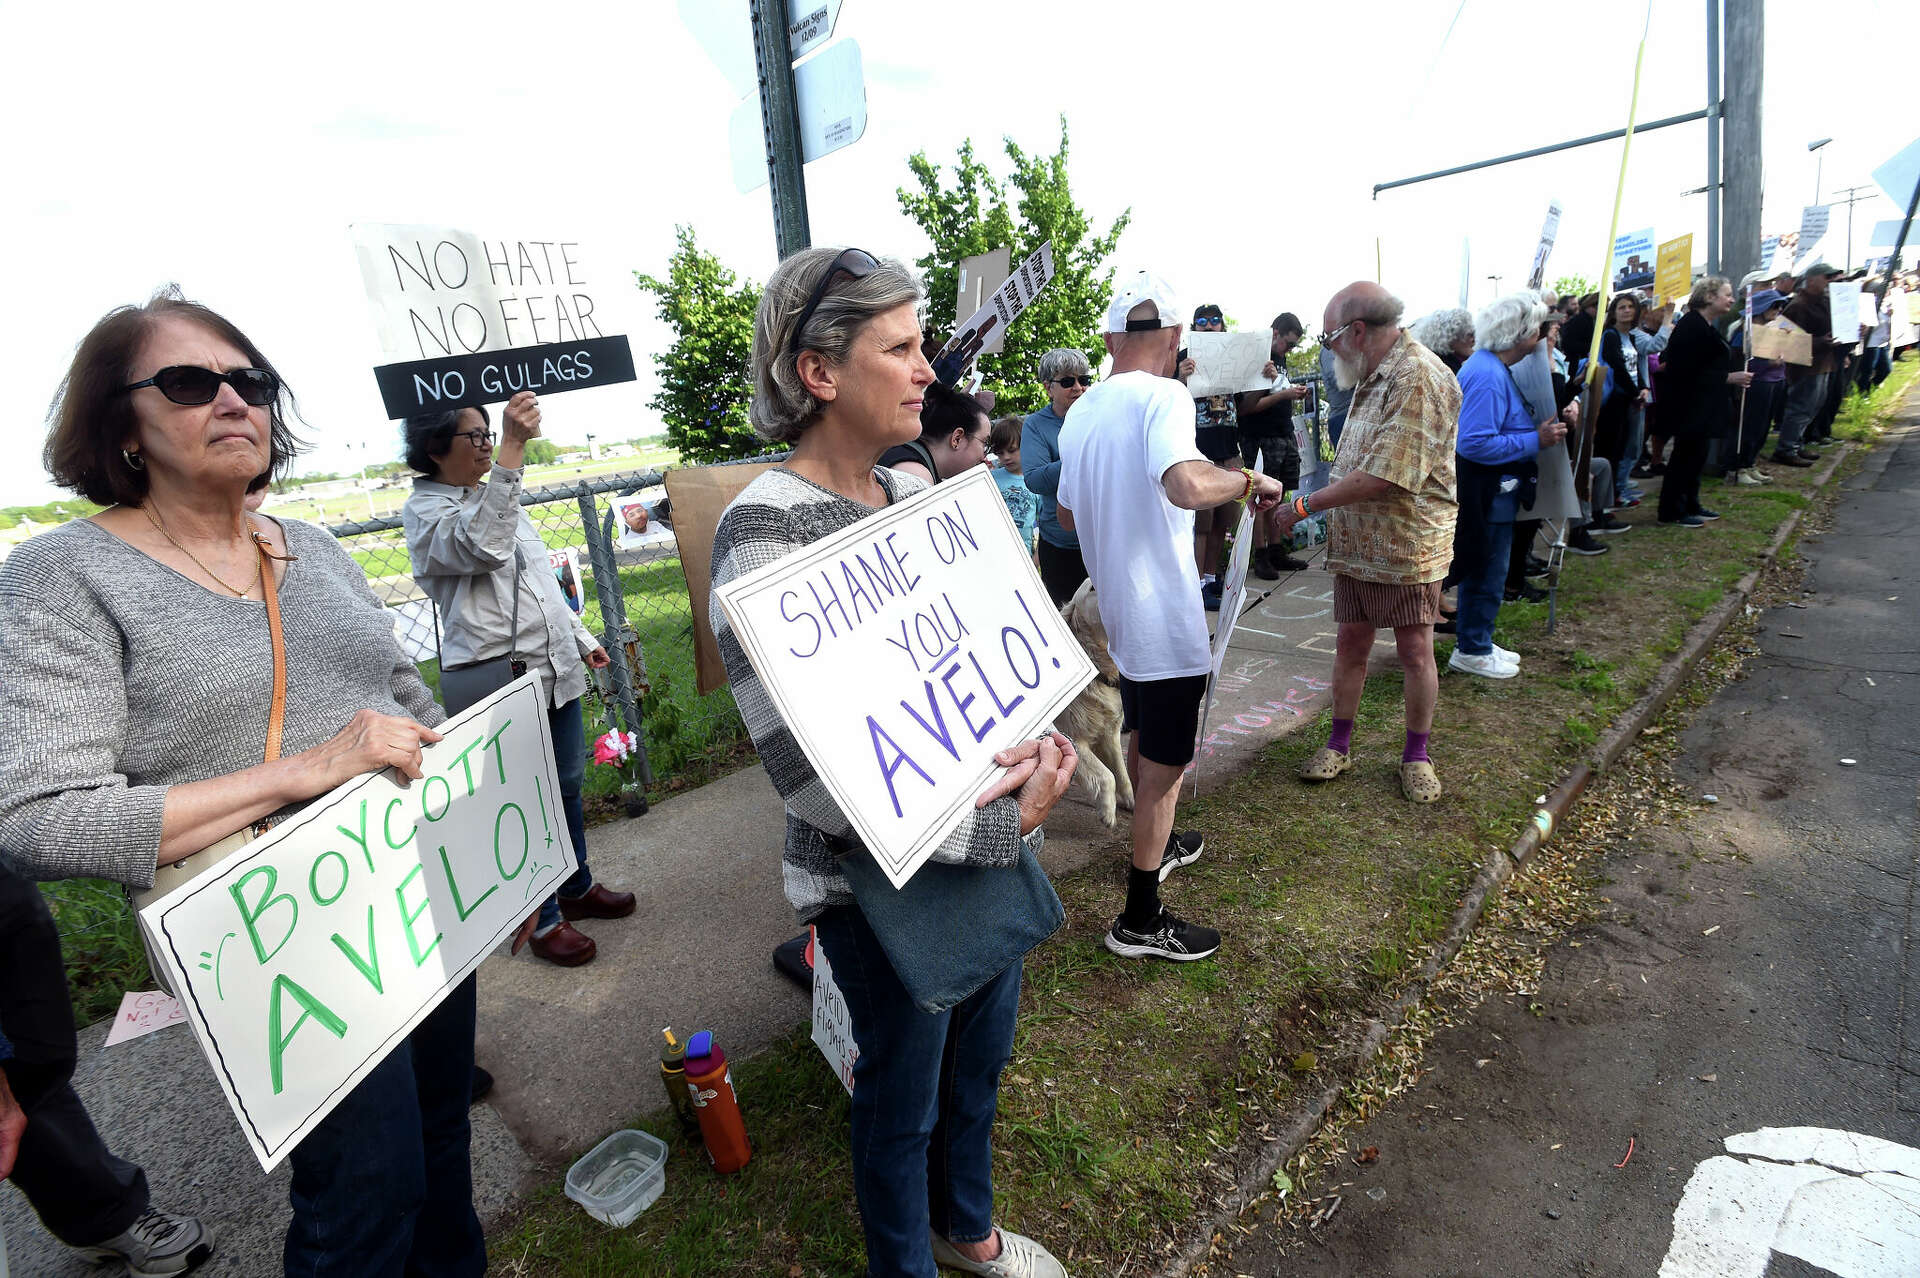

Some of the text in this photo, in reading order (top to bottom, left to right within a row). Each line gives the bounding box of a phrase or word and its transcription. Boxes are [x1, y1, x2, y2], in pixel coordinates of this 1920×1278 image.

[789, 9, 828, 36] Vulcan Signs
[388, 240, 587, 291] NO HATE
[1004, 280, 1023, 315] STOP THE
[1030, 252, 1047, 289] STOP THE
[409, 294, 604, 358] NO FEAR
[413, 351, 593, 405] NO GULAGS
[780, 500, 979, 658] SHAME ON
[886, 593, 970, 672] YOU
[866, 590, 1060, 818] AVELO!
[229, 719, 512, 965] BOYCOTT
[269, 776, 554, 1095] AVELO!
